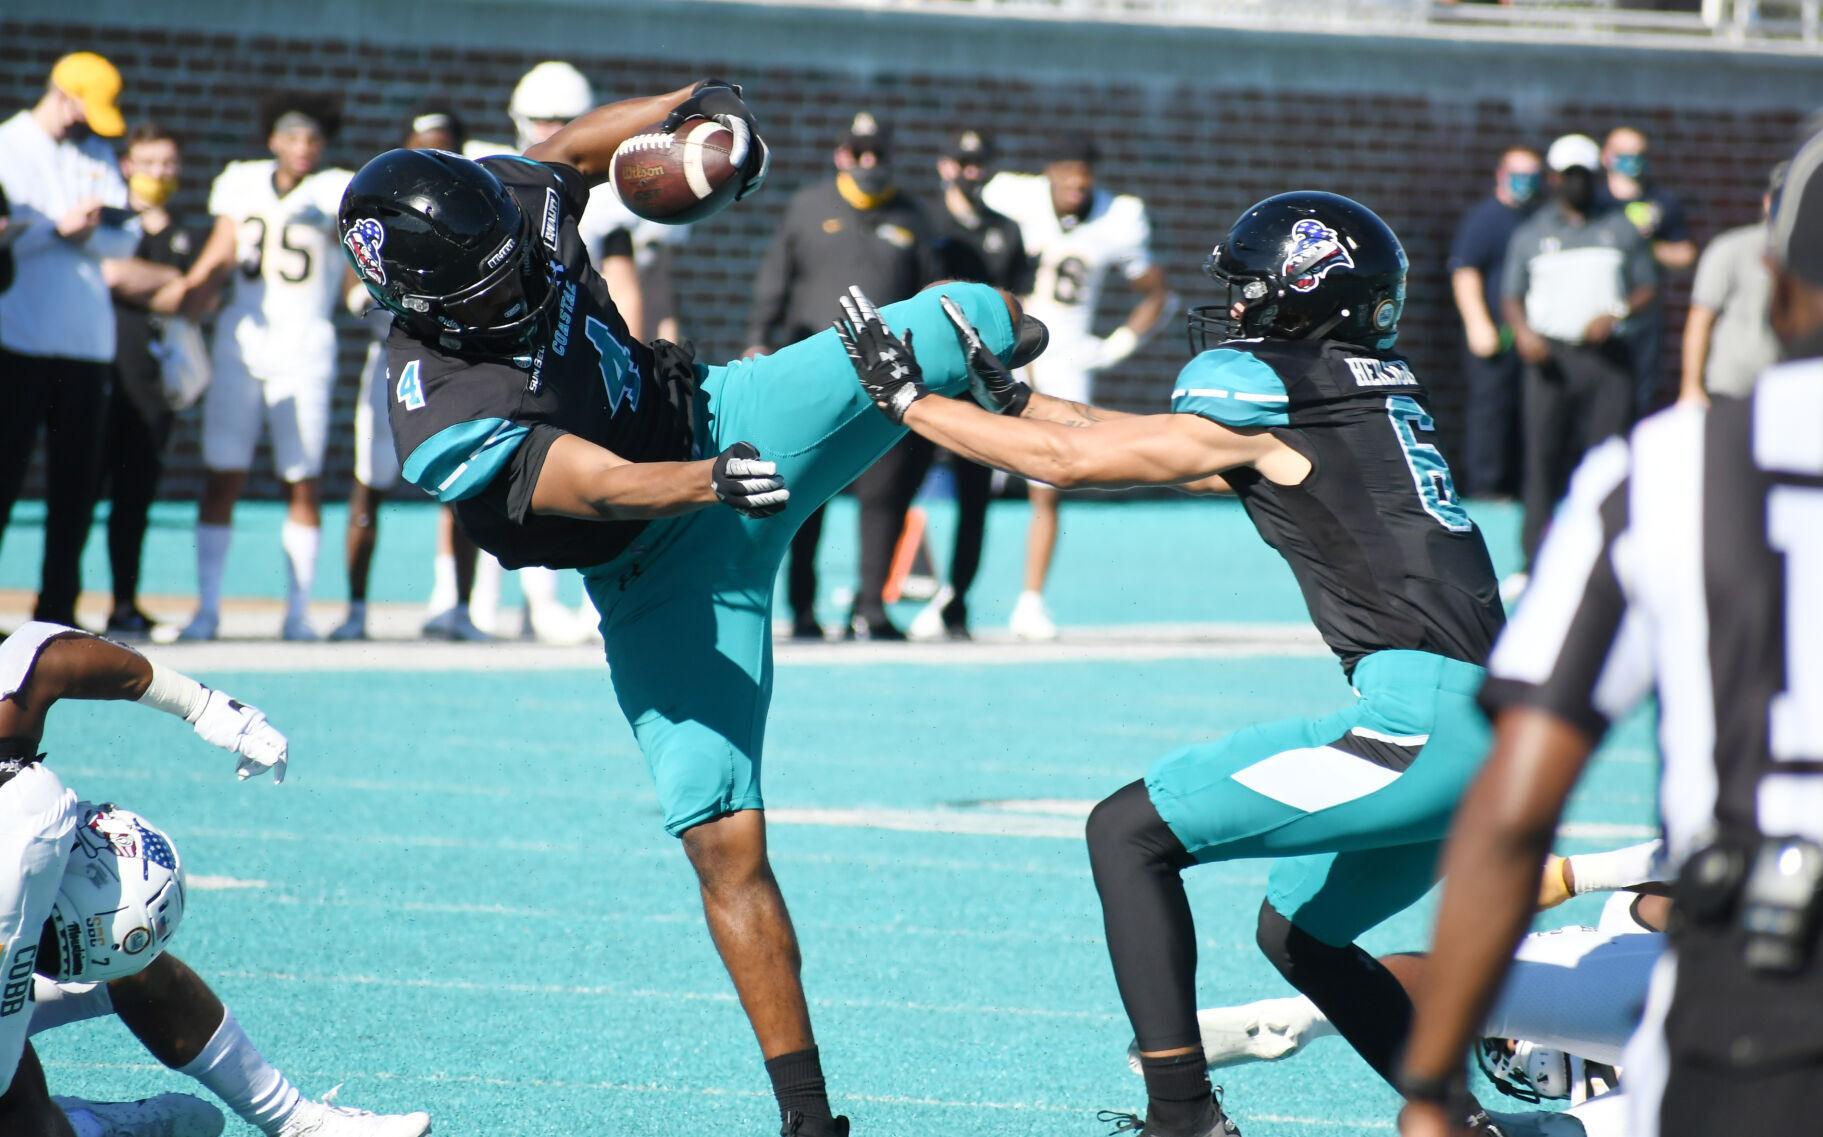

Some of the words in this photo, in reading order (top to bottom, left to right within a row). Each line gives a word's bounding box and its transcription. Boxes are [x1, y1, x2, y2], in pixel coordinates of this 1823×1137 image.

[622, 165, 665, 180] Wilson
[240, 214, 314, 284] 35
[529, 368, 542, 393] SUN
[533, 345, 546, 368] BEL
[584, 315, 641, 420] 4
[397, 360, 426, 411] 4
[1386, 395, 1472, 532] 6
[1, 944, 39, 1018] COBB
[91, 957, 110, 967] 7
